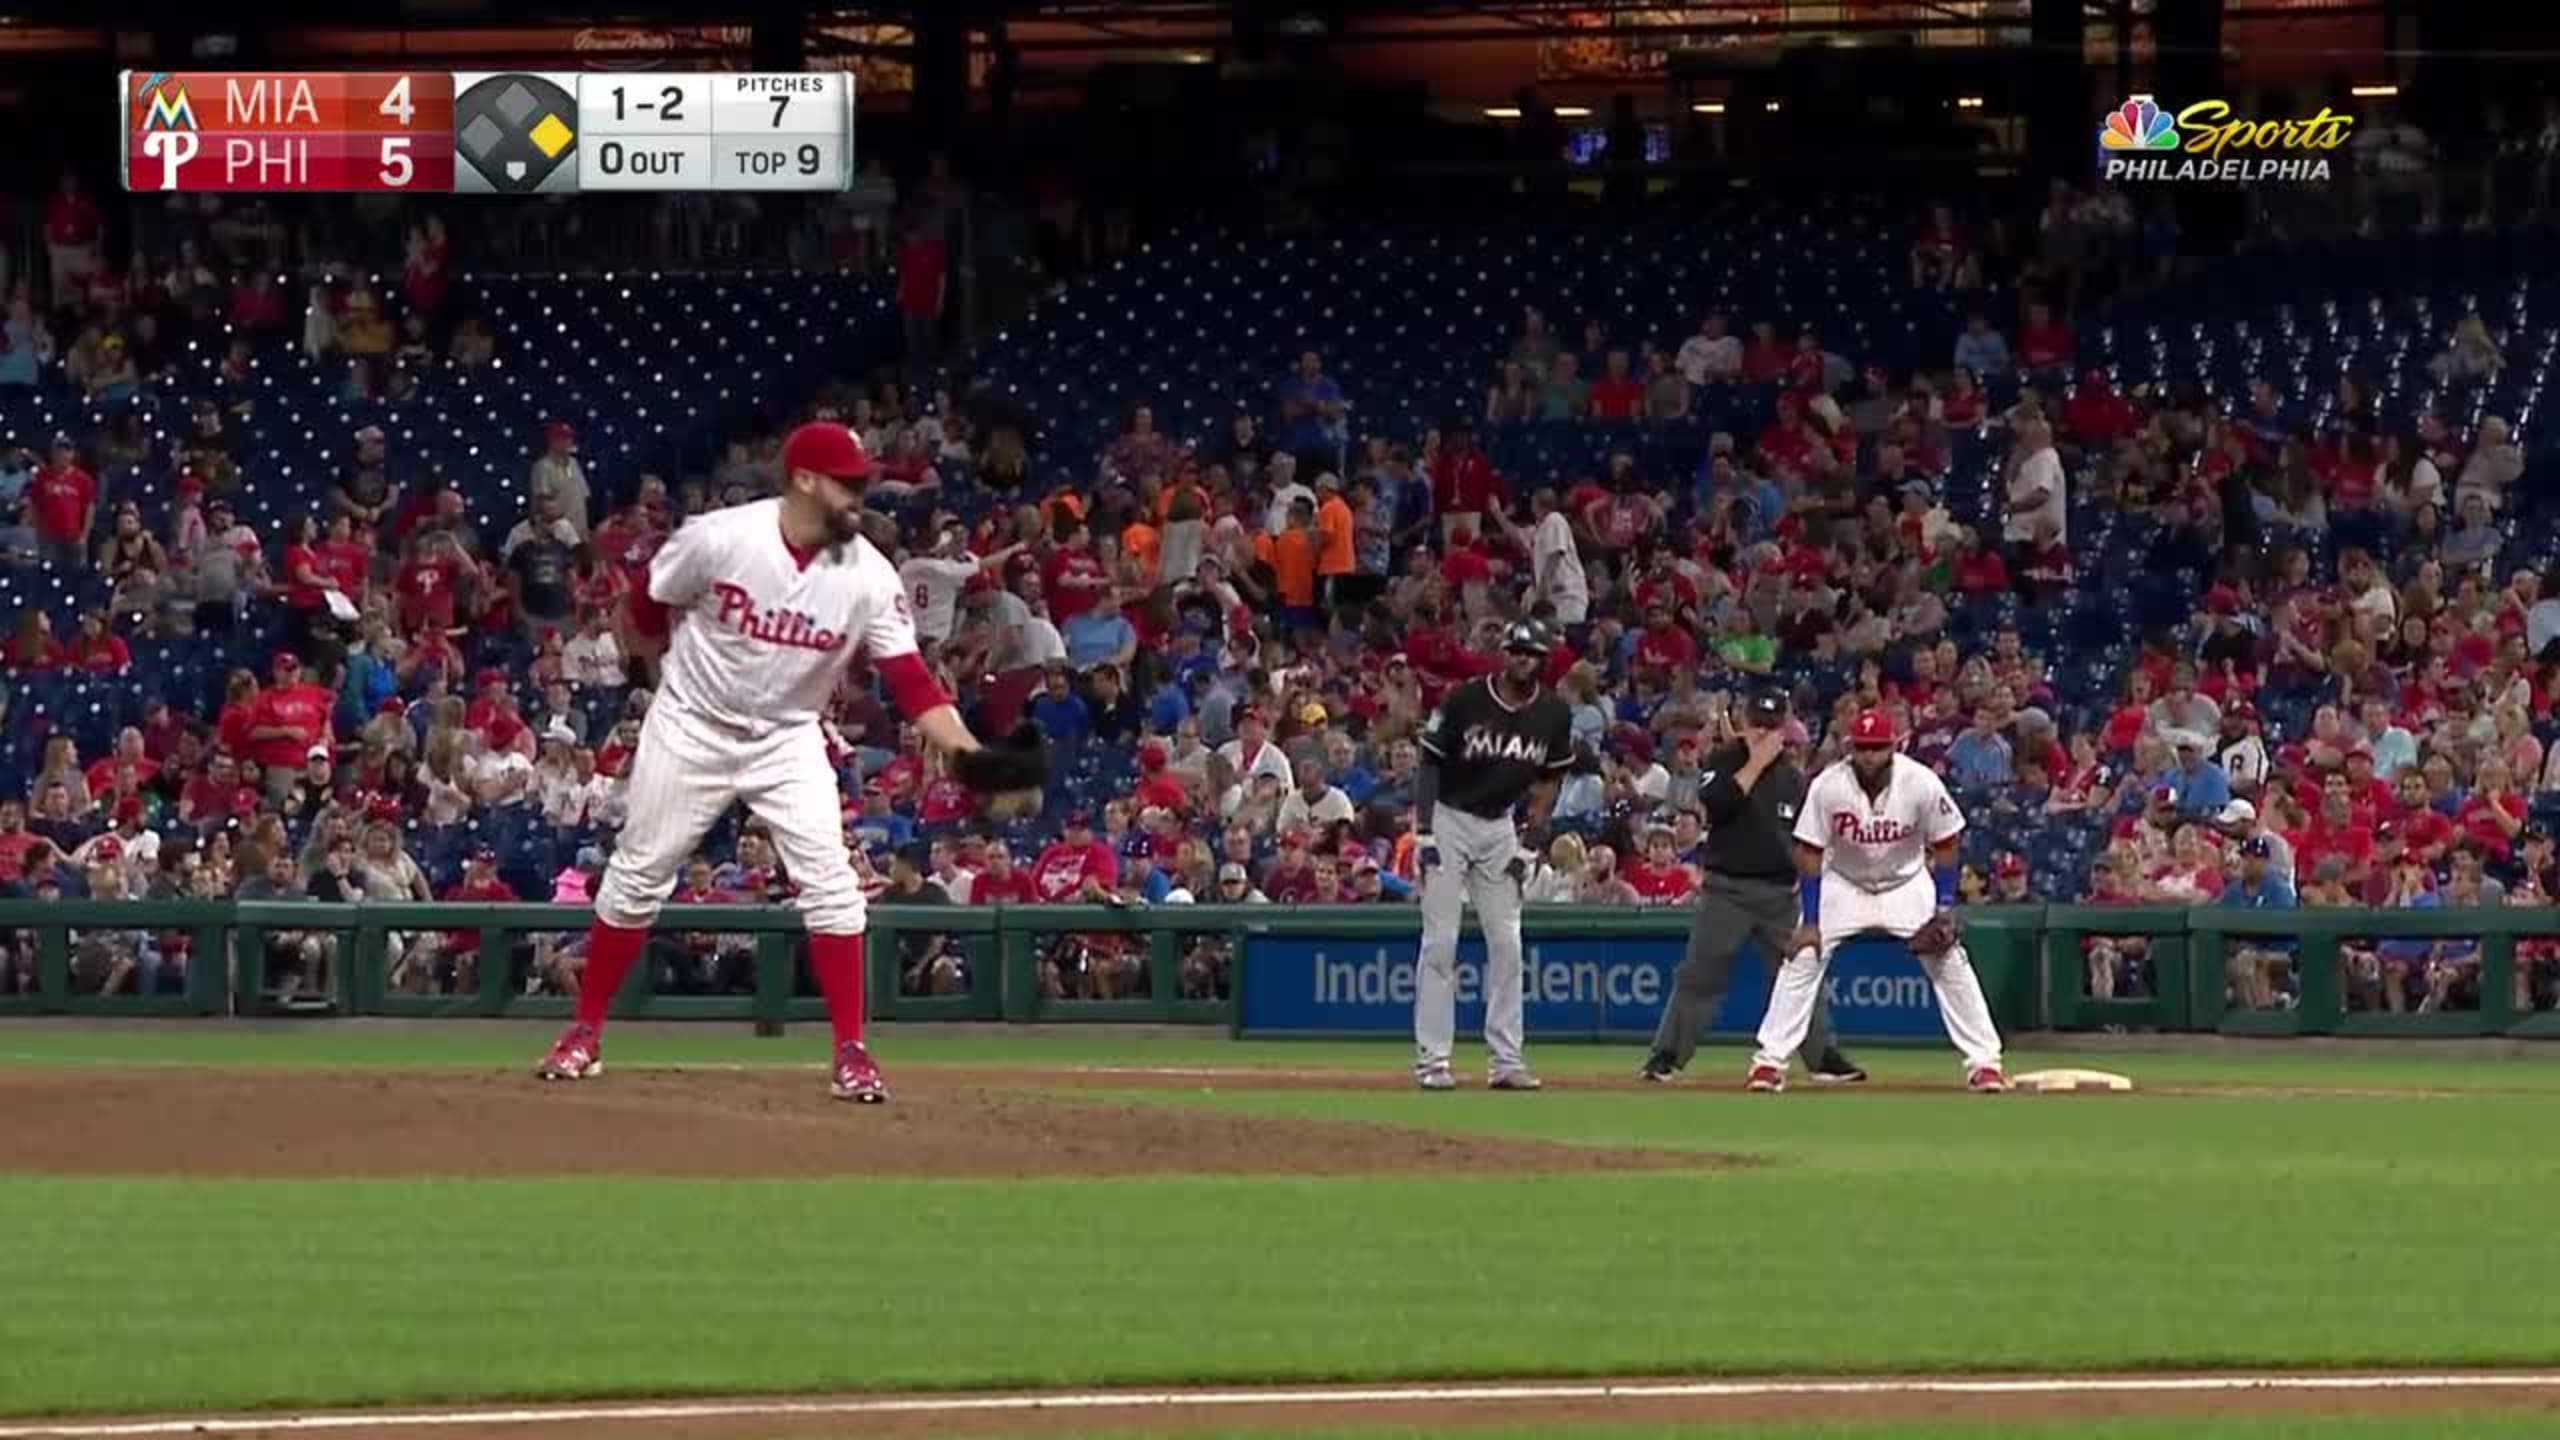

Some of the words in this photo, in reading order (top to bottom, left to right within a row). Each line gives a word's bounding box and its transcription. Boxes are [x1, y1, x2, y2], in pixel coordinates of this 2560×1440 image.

[1464, 729, 1549, 767] MIAM
[1834, 811, 1918, 844] Phillie
[1313, 949, 1661, 1005] Indeedence
